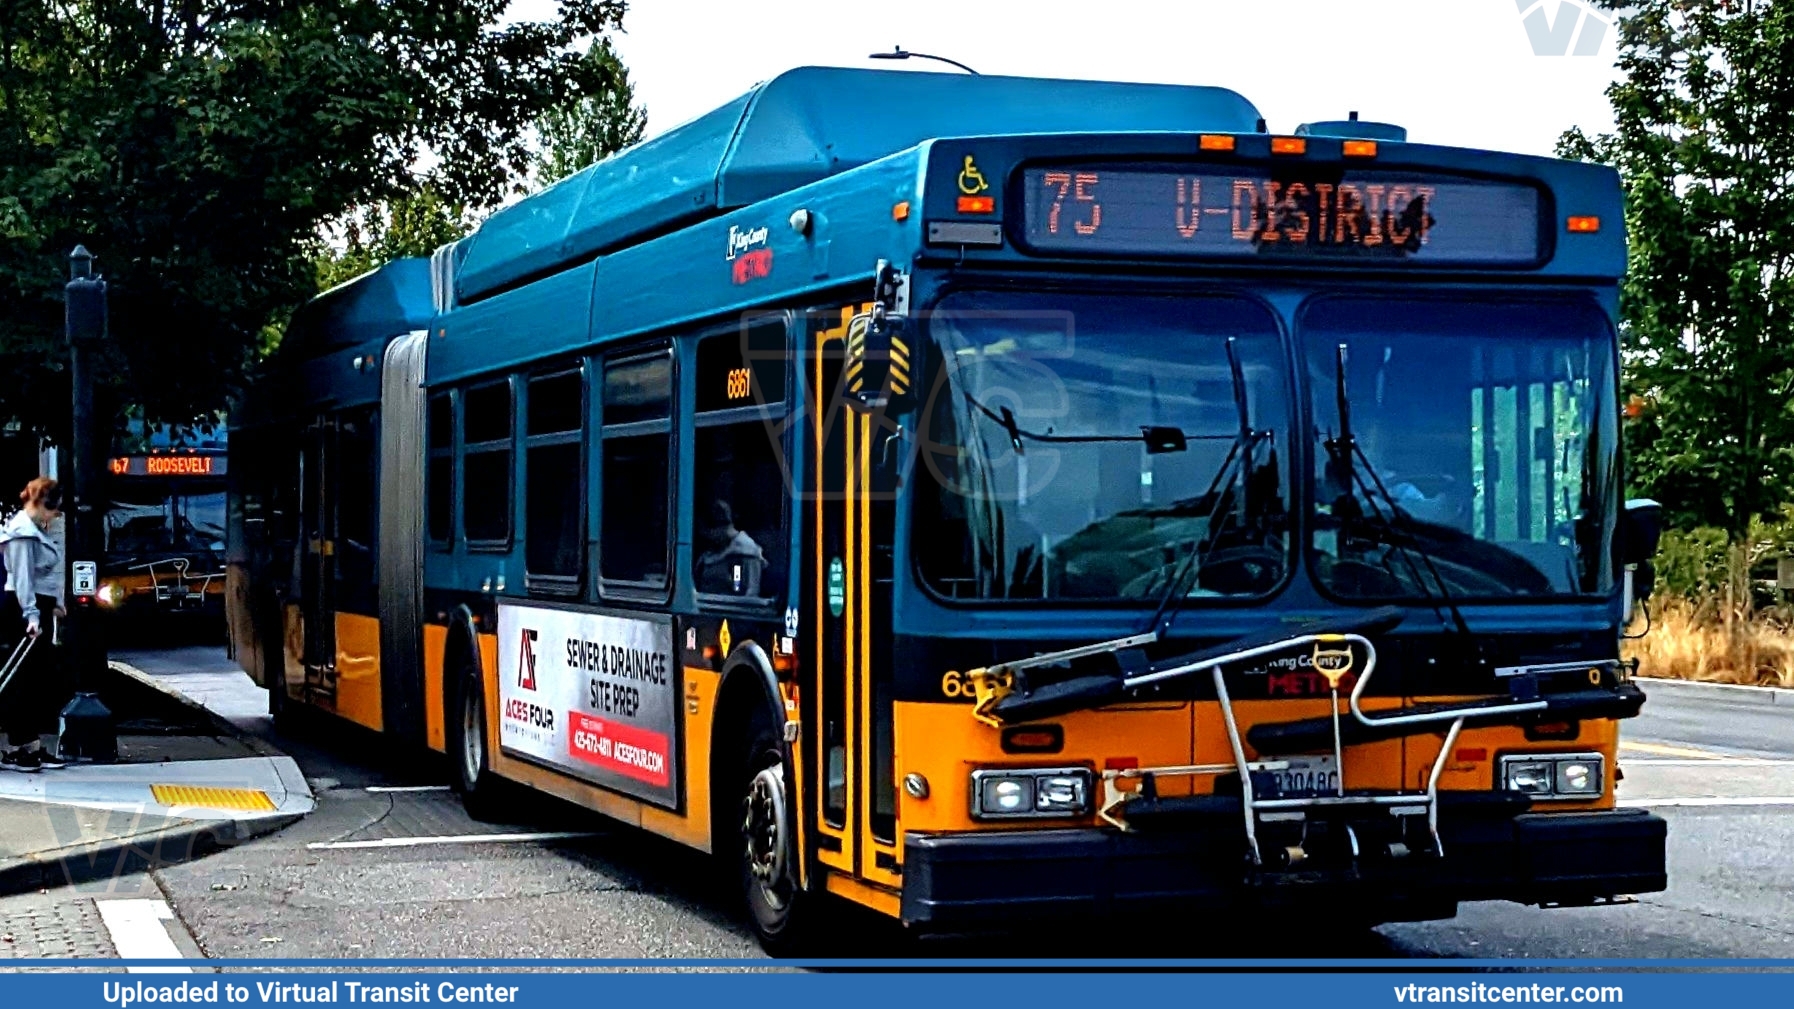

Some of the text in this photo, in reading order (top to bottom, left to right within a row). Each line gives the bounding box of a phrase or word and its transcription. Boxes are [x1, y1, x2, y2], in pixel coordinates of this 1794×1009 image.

[1044, 172, 1436, 246] 75 U-DISTRICT
[727, 368, 750, 400] 6861
[148, 457, 212, 473] ROOSEVELT
[567, 638, 666, 685] SEWER & DRAINAGE
[1298, 654, 1342, 670] Conty
[505, 698, 528, 723] ACES
[529, 704, 554, 731] FOUR
[590, 678, 639, 718] SITE PREP
[613, 741, 664, 775] ACESFOUR.COM
